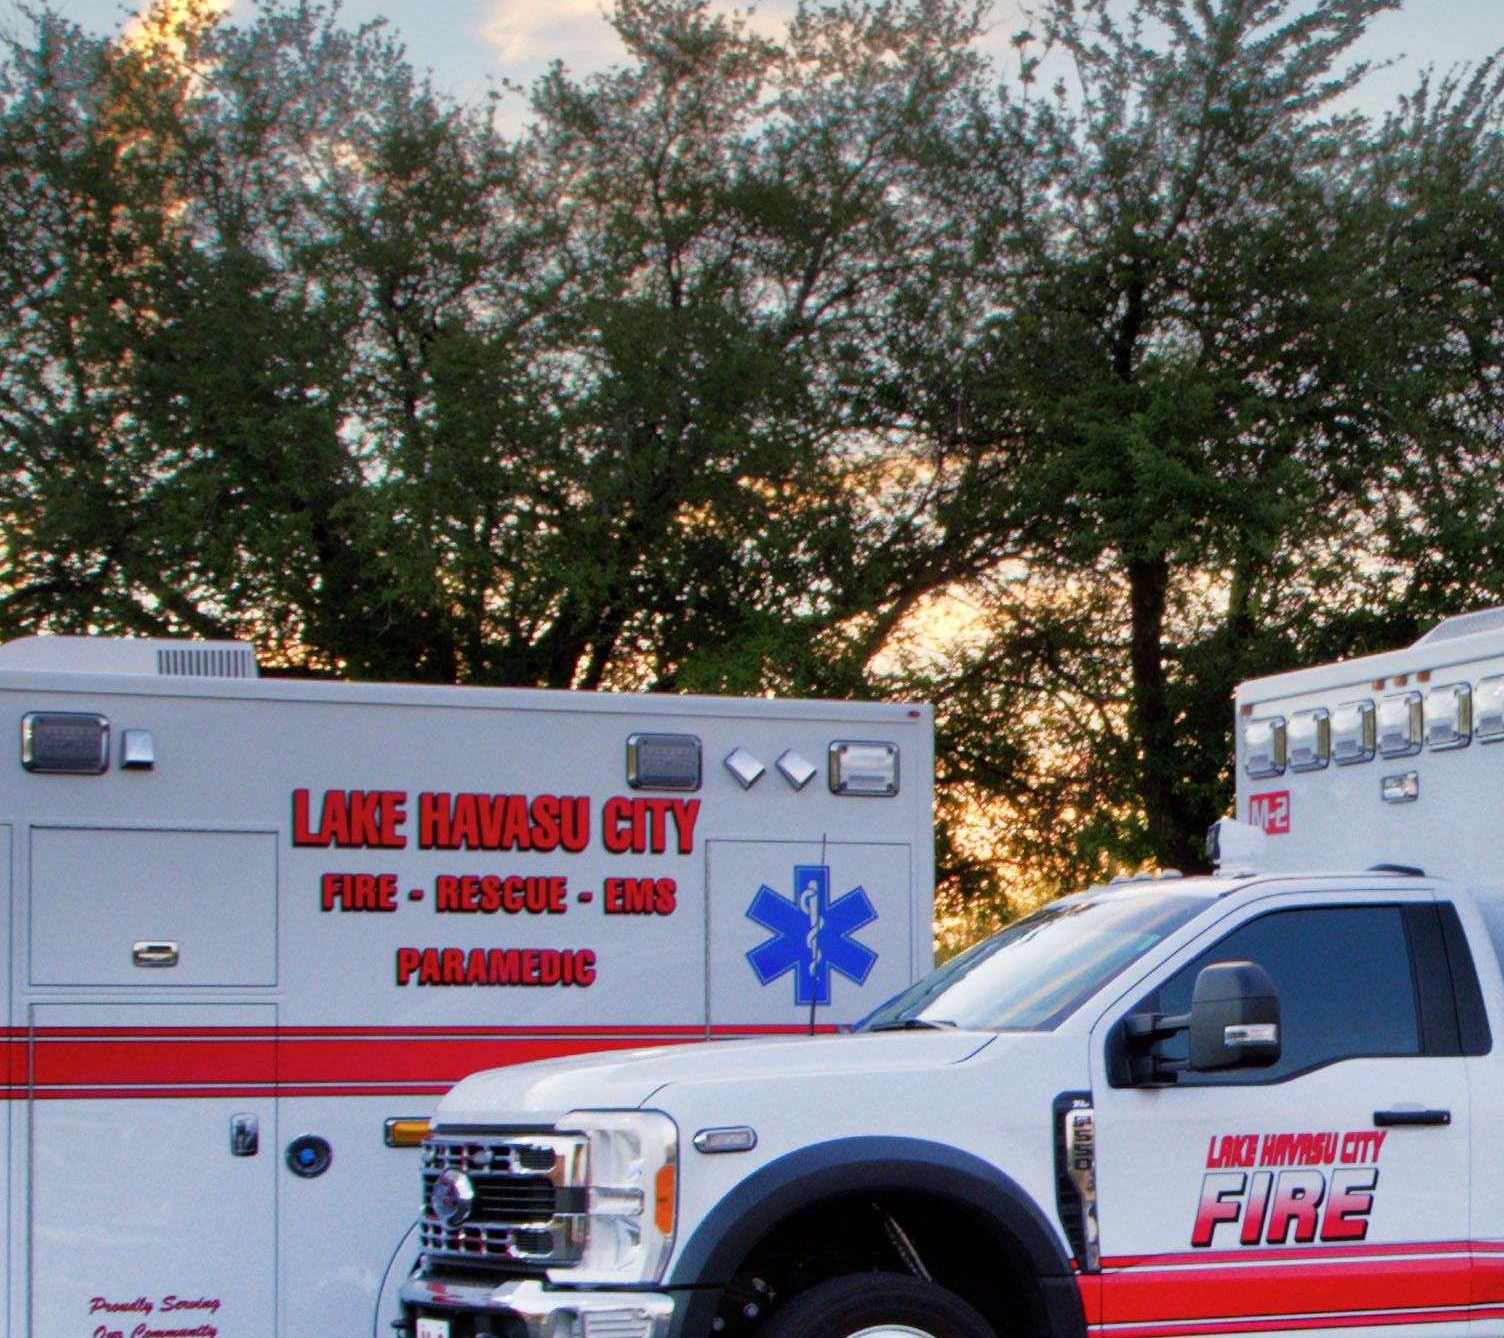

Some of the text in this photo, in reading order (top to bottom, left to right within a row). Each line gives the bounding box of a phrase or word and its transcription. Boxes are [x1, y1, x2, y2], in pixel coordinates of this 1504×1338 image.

[292, 788, 702, 854] LAKE HAVASU CITY
[1251, 795, 1288, 829] M-2
[321, 873, 398, 912] FIRE
[435, 874, 567, 914] RESCUE
[603, 877, 677, 915] EMS
[396, 947, 596, 987] PARAMEDIC
[1206, 1130, 1388, 1169] LAKE HAVASU CITY
[1191, 1167, 1379, 1247] FIRE
[89, 1295, 221, 1316] Proudly Serving
